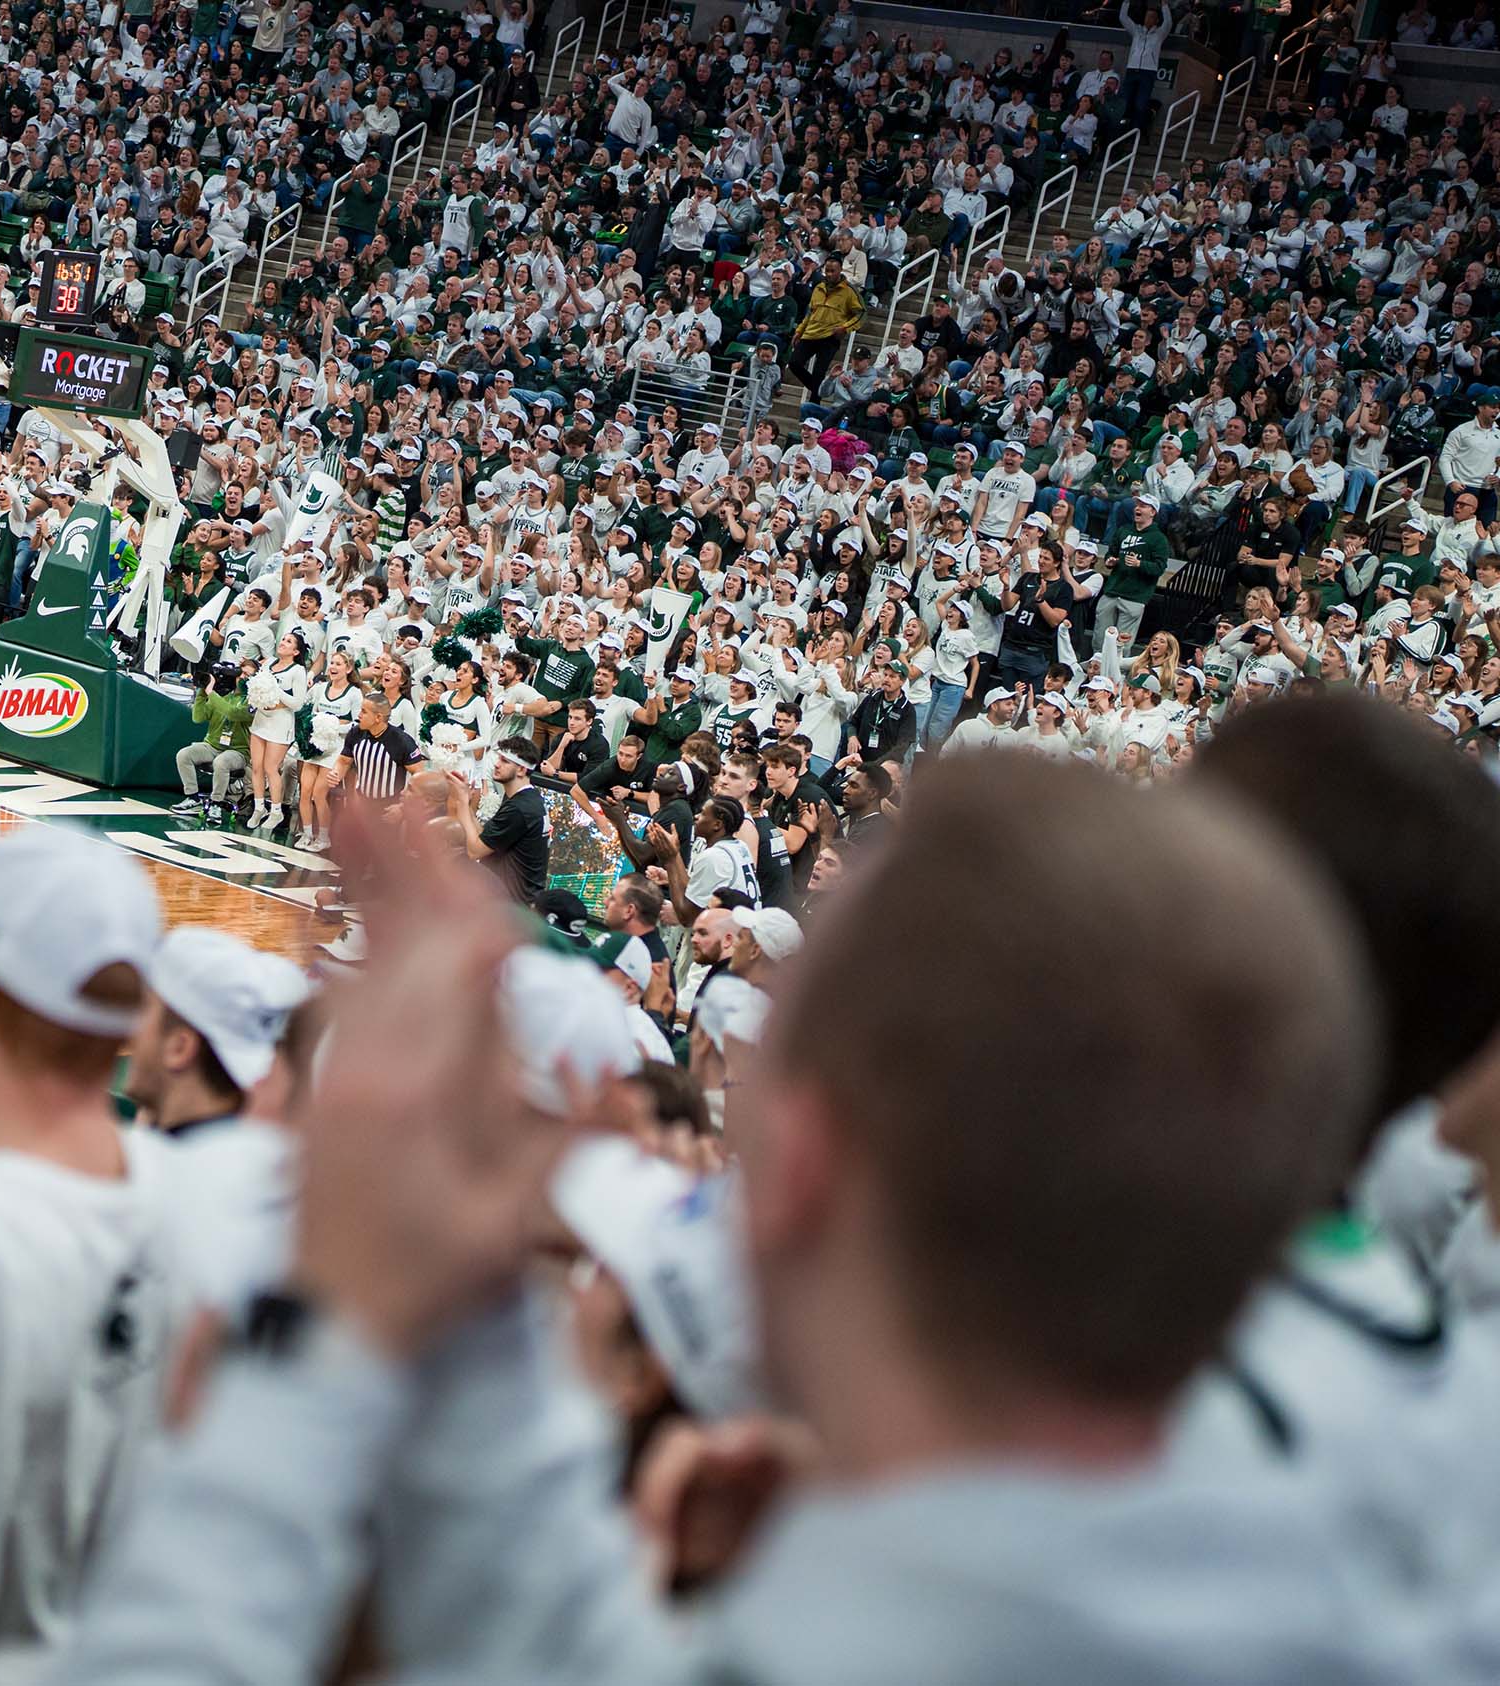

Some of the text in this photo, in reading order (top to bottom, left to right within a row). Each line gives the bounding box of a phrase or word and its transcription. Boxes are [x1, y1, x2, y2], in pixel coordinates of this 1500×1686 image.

[56, 263, 91, 282] 16:51
[56, 285, 79, 312] 30
[40, 347, 130, 385] ROCKET
[54, 378, 106, 402] Mortgage
[1018, 610, 1035, 627] 21
[716, 727, 732, 745] 55
